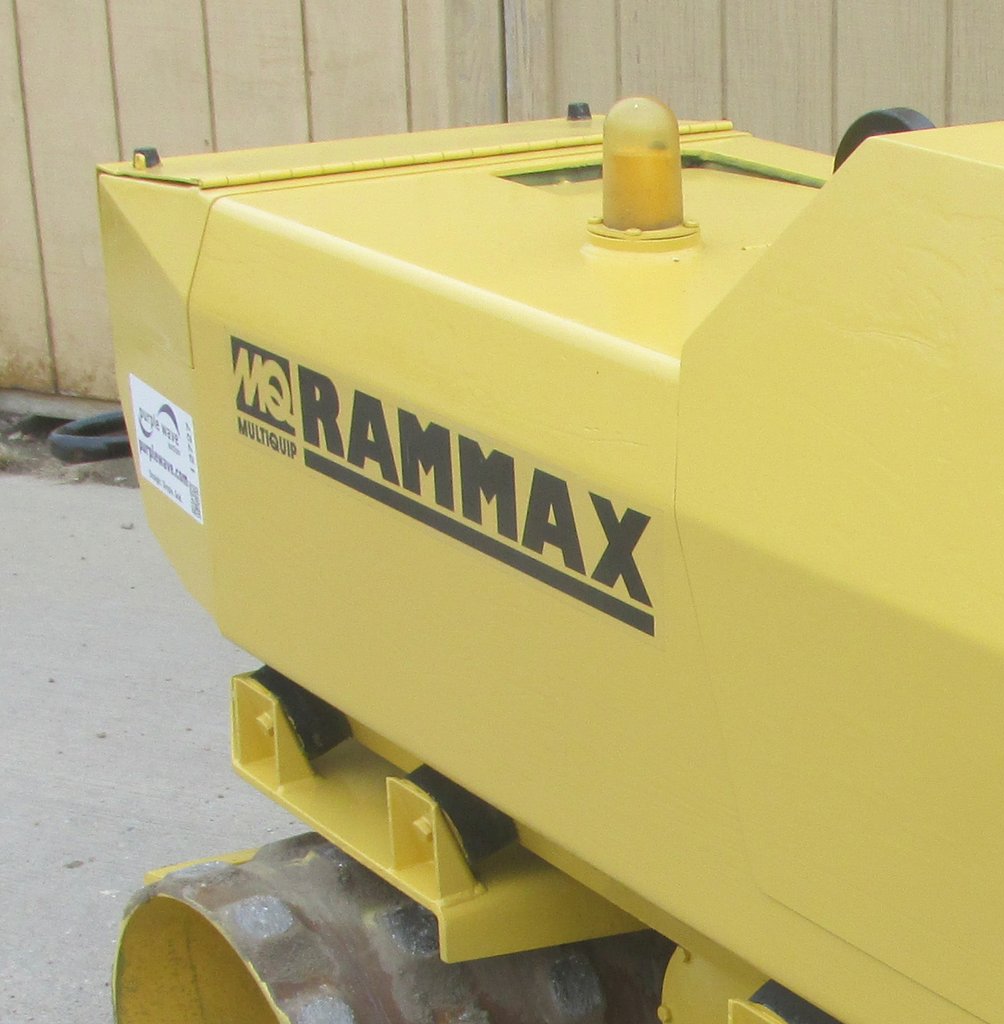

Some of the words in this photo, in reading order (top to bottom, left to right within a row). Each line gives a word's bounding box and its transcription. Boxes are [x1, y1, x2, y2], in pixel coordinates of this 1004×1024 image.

[138, 408, 160, 432] purple
[161, 424, 180, 446] wave
[238, 417, 297, 459] MULTIQUIP
[138, 439, 189, 487] purplewave.com
[298, 365, 653, 608] RAMMAX
